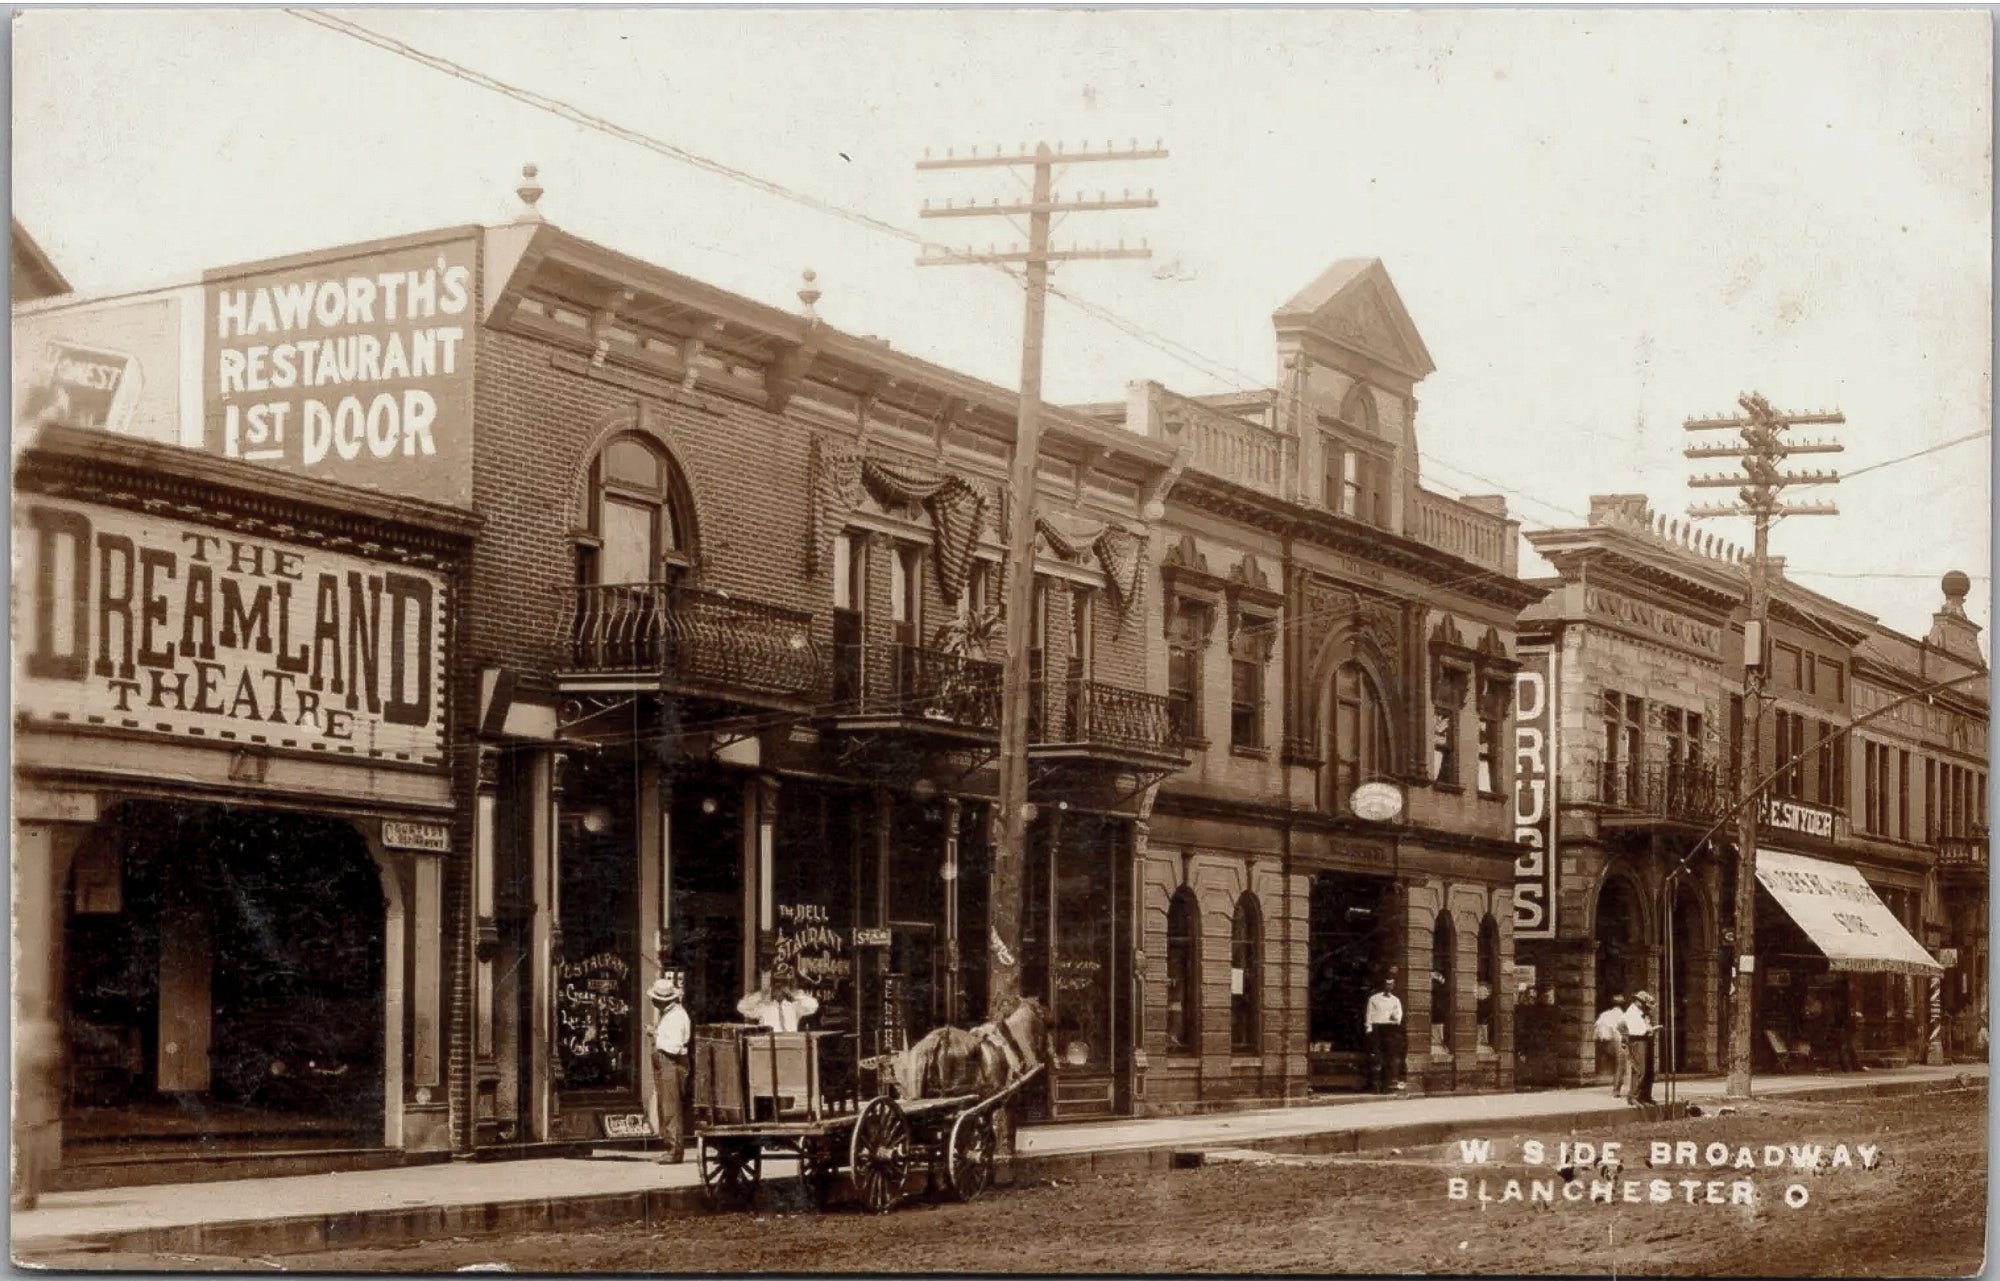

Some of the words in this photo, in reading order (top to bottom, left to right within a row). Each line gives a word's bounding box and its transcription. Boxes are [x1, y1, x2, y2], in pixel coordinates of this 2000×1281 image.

[218, 255, 469, 338] HAWORTH'S
[220, 327, 464, 394] RESTAURANT
[303, 389, 437, 465] DOOR
[182, 531, 306, 580] THE
[27, 505, 434, 728] DREAMLAND
[108, 661, 357, 740] THEATRE
[1513, 671, 1546, 928] DRUGS
